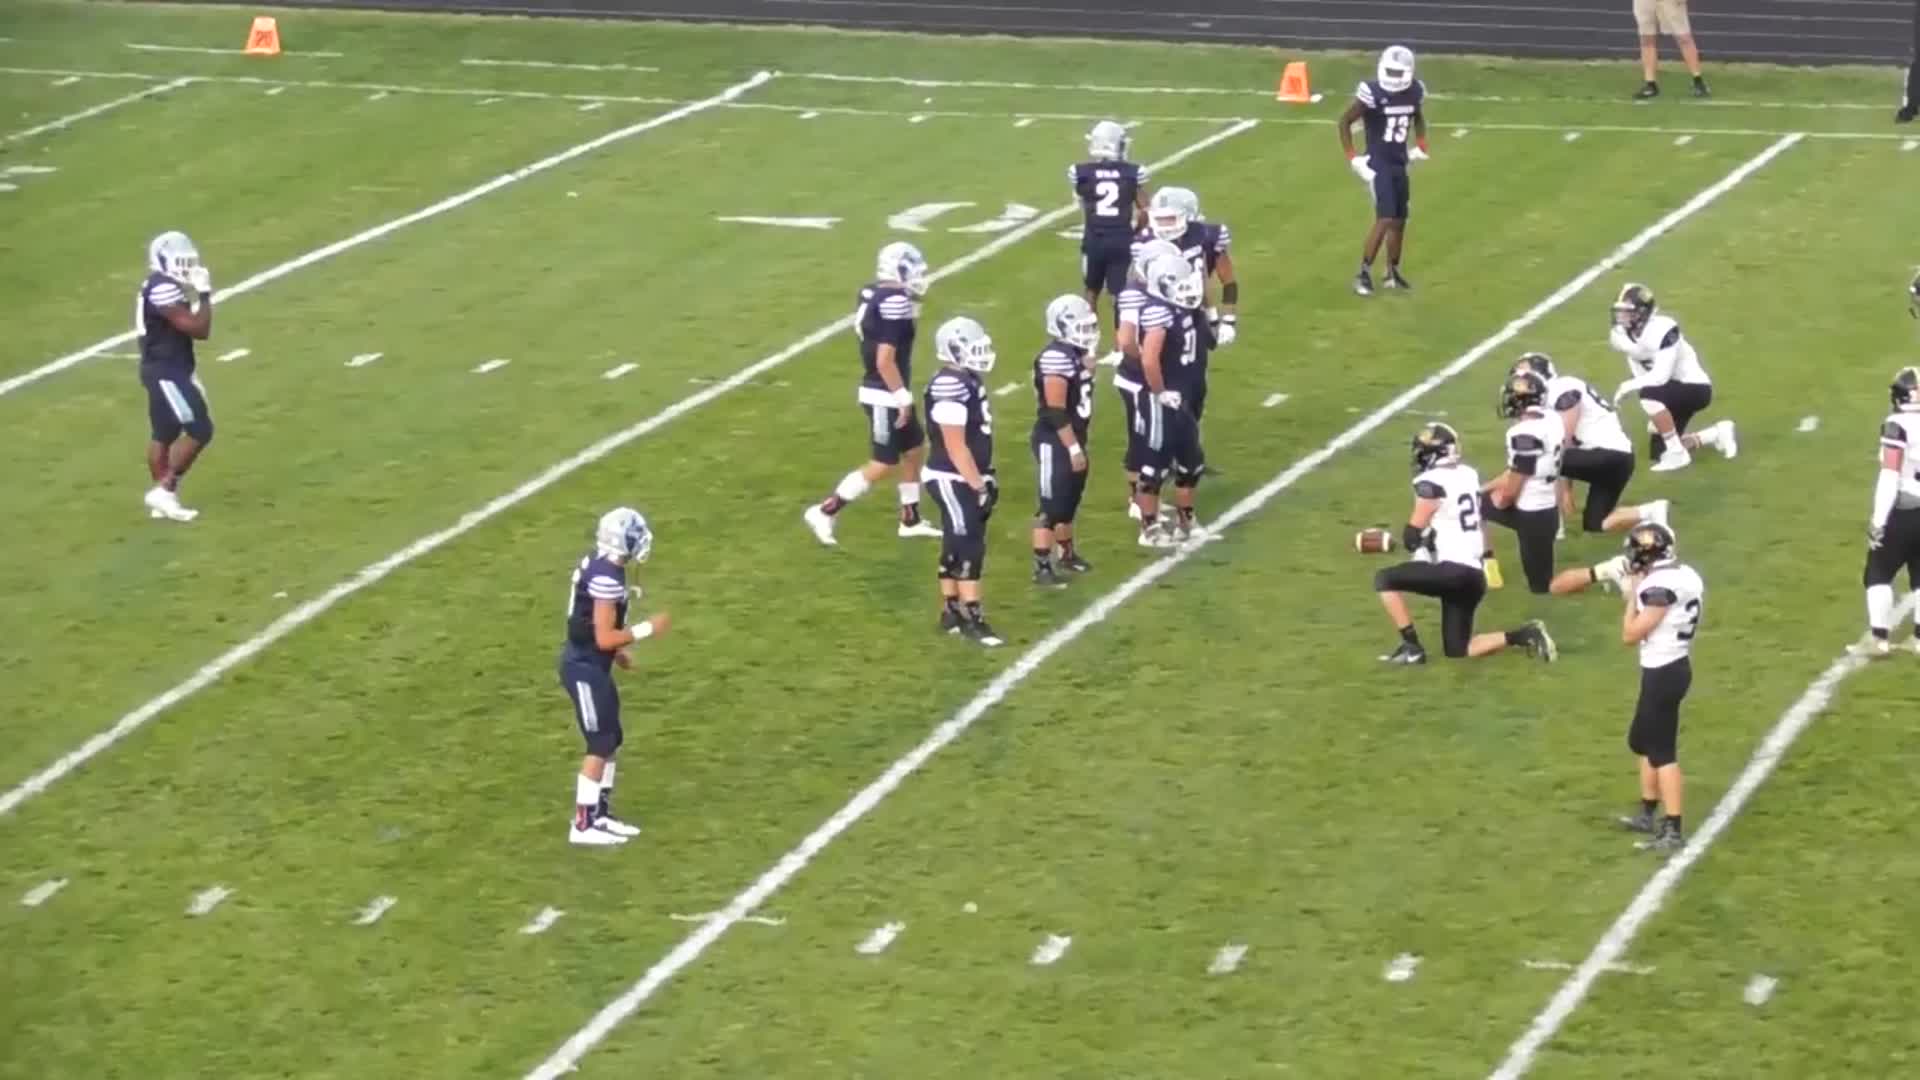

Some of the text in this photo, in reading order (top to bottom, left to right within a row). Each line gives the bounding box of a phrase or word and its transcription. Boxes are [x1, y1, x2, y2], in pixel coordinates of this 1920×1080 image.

[1383, 115, 1408, 143] 13
[1095, 181, 1120, 216] 2
[1457, 491, 1481, 533] 2
[1676, 598, 1701, 641] 3
